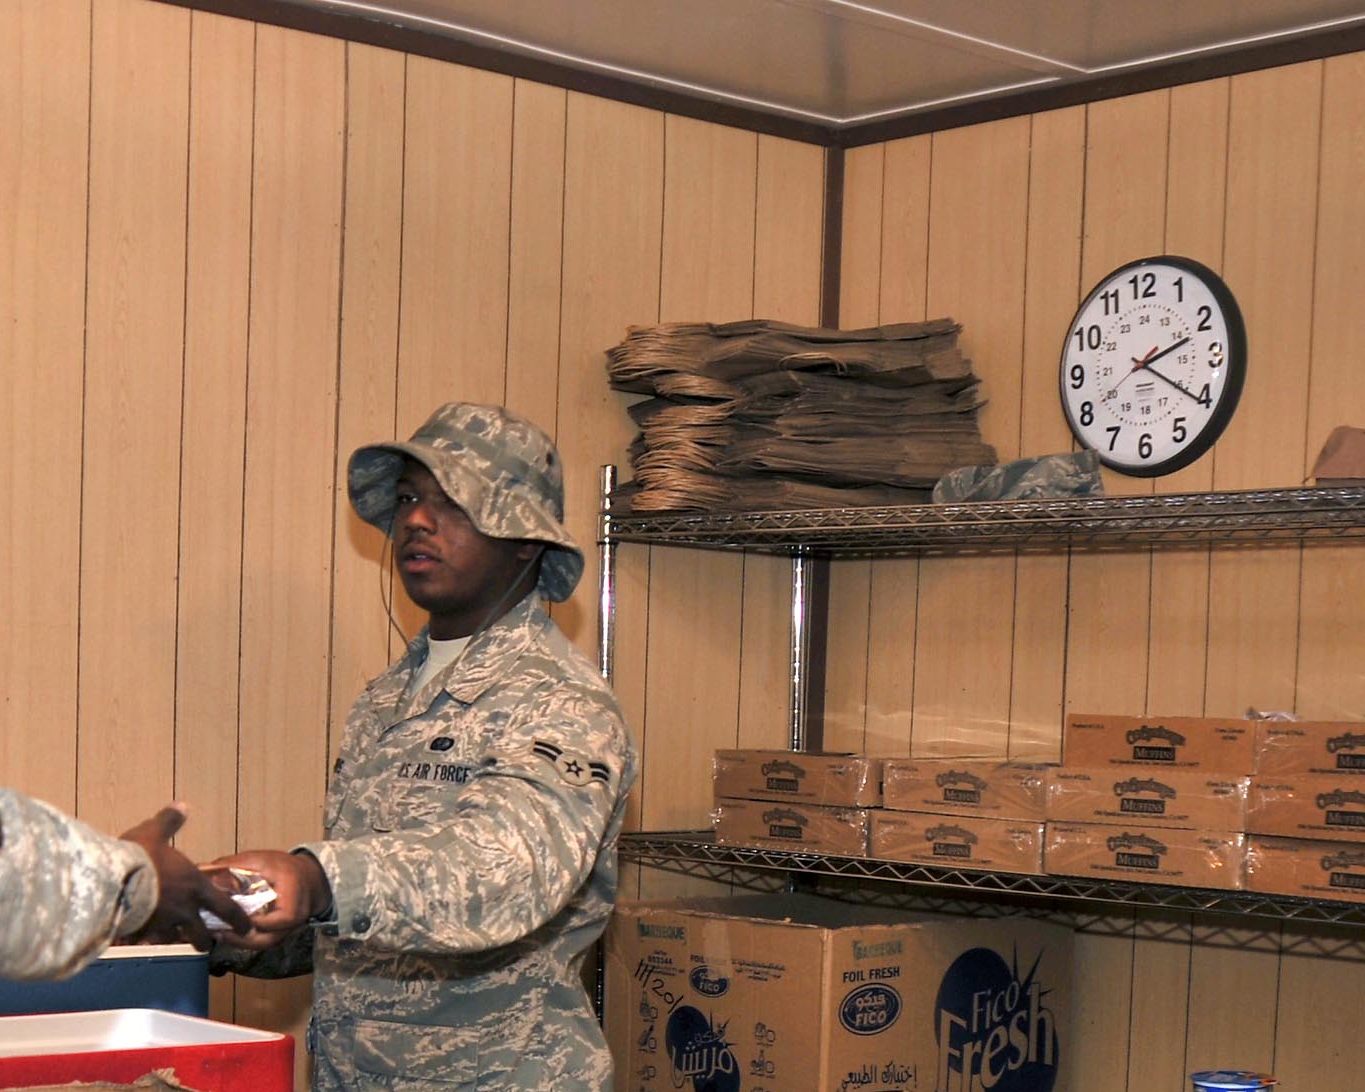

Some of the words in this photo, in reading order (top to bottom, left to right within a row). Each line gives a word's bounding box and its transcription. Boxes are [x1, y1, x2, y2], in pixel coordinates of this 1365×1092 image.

[1129, 272, 1156, 300] 12
[1173, 277, 1183, 302] 1
[1100, 289, 1119, 315] 11
[1120, 325, 1130, 334] 23
[1139, 315, 1150, 325] 24
[1160, 316, 1170, 326] 13
[1197, 305, 1211, 332] 2
[1074, 325, 1101, 351] 10
[1107, 343, 1116, 351] 22
[1172, 332, 1183, 341] 14
[1177, 355, 1188, 364] 15
[1208, 342, 1223, 368] 3
[1071, 364, 1084, 389] 9
[1103, 367, 1112, 375] 21
[1121, 403, 1131, 412] 19
[1158, 397, 1168, 406] 17
[1197, 383, 1212, 408] 4
[1080, 401, 1094, 426] 8
[1140, 406, 1150, 414] 18
[1106, 426, 1121, 451] 7
[1172, 417, 1187, 442] 5
[1138, 434, 1152, 459] 6
[843, 971, 865, 982] FOIL
[869, 967, 899, 978] FRESH
[856, 1010, 885, 1026] FICO
[973, 981, 1019, 1032] Fico
